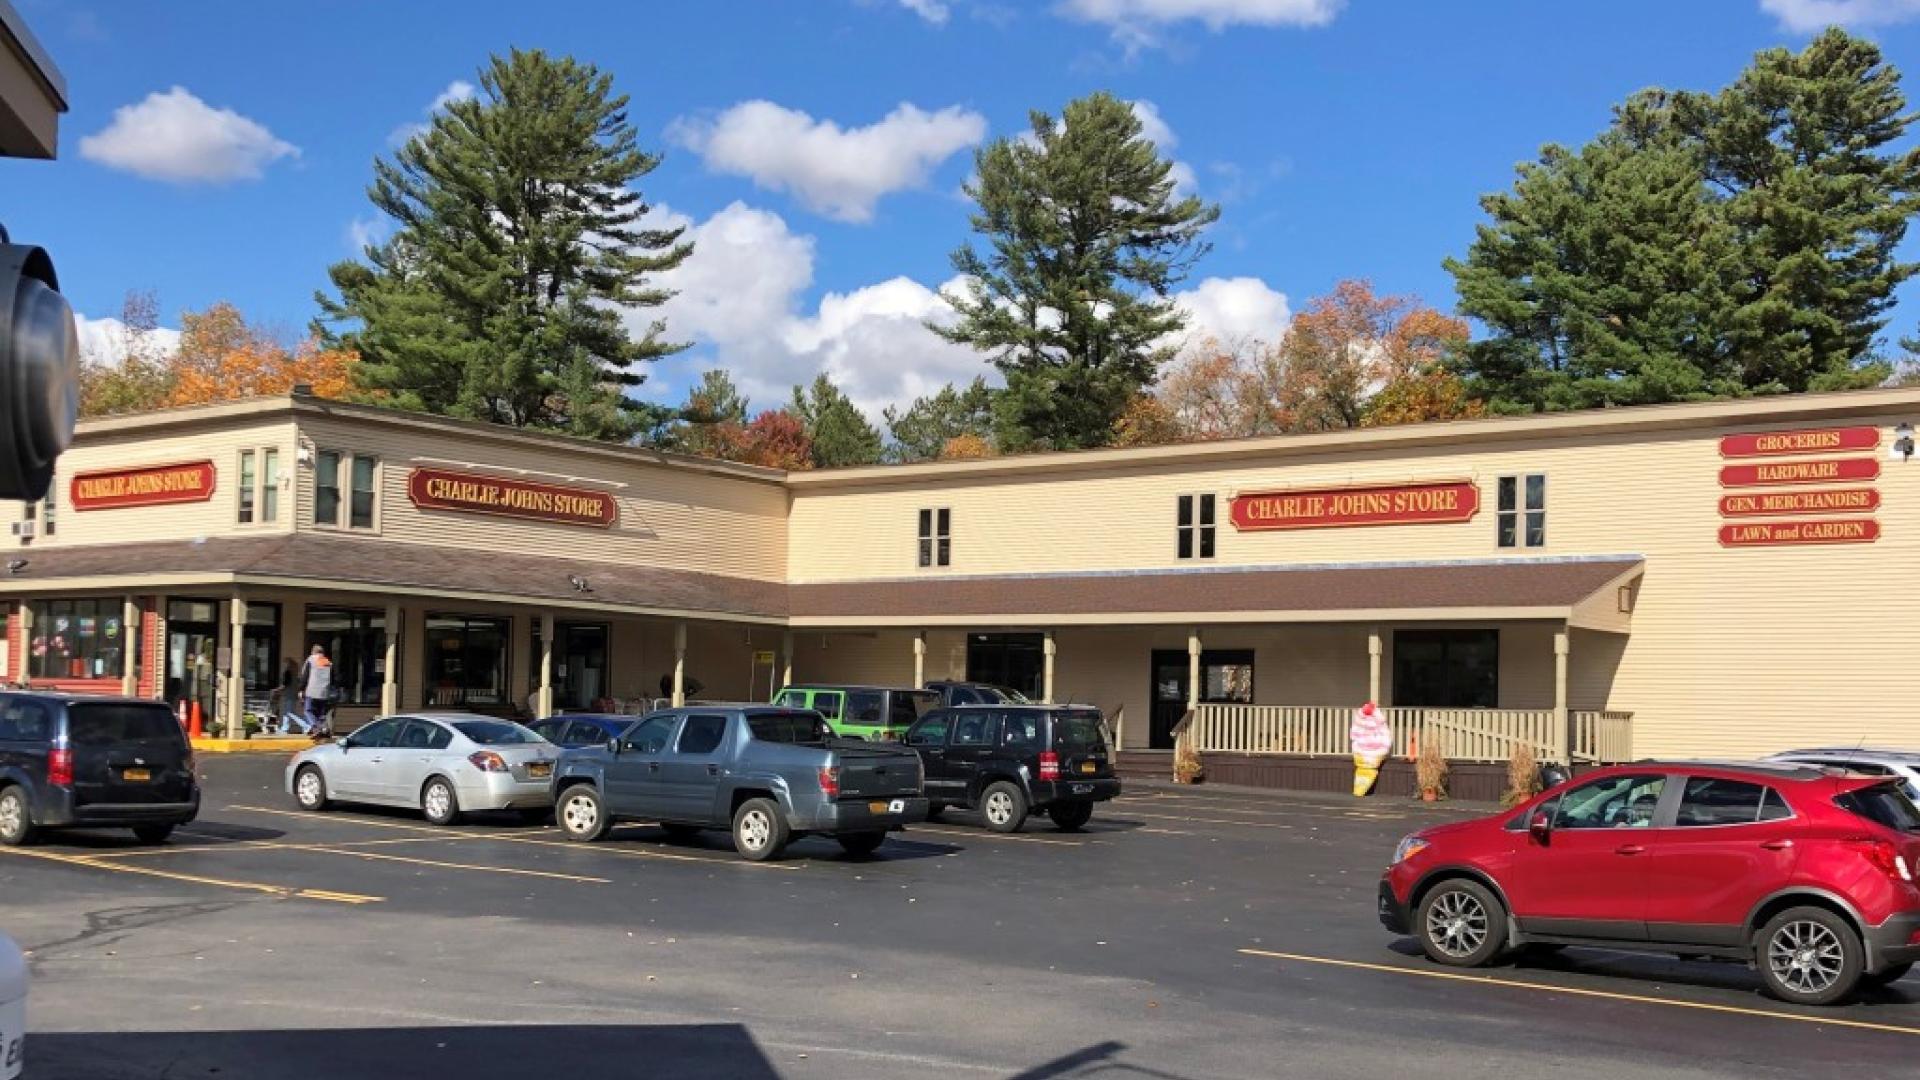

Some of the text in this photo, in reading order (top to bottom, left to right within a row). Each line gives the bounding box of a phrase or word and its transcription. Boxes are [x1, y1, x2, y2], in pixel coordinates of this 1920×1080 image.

[1756, 432, 1840, 450] GROCERIES
[1757, 462, 1838, 480] HARDWARE
[427, 478, 603, 517] CHARLIE JOHNS STORE
[1247, 490, 1458, 519] CHARLIE JOHNS STORE
[1726, 491, 1870, 512] GEN. MERCHANDISE
[1731, 522, 1865, 541] LAWN and GARDEN
